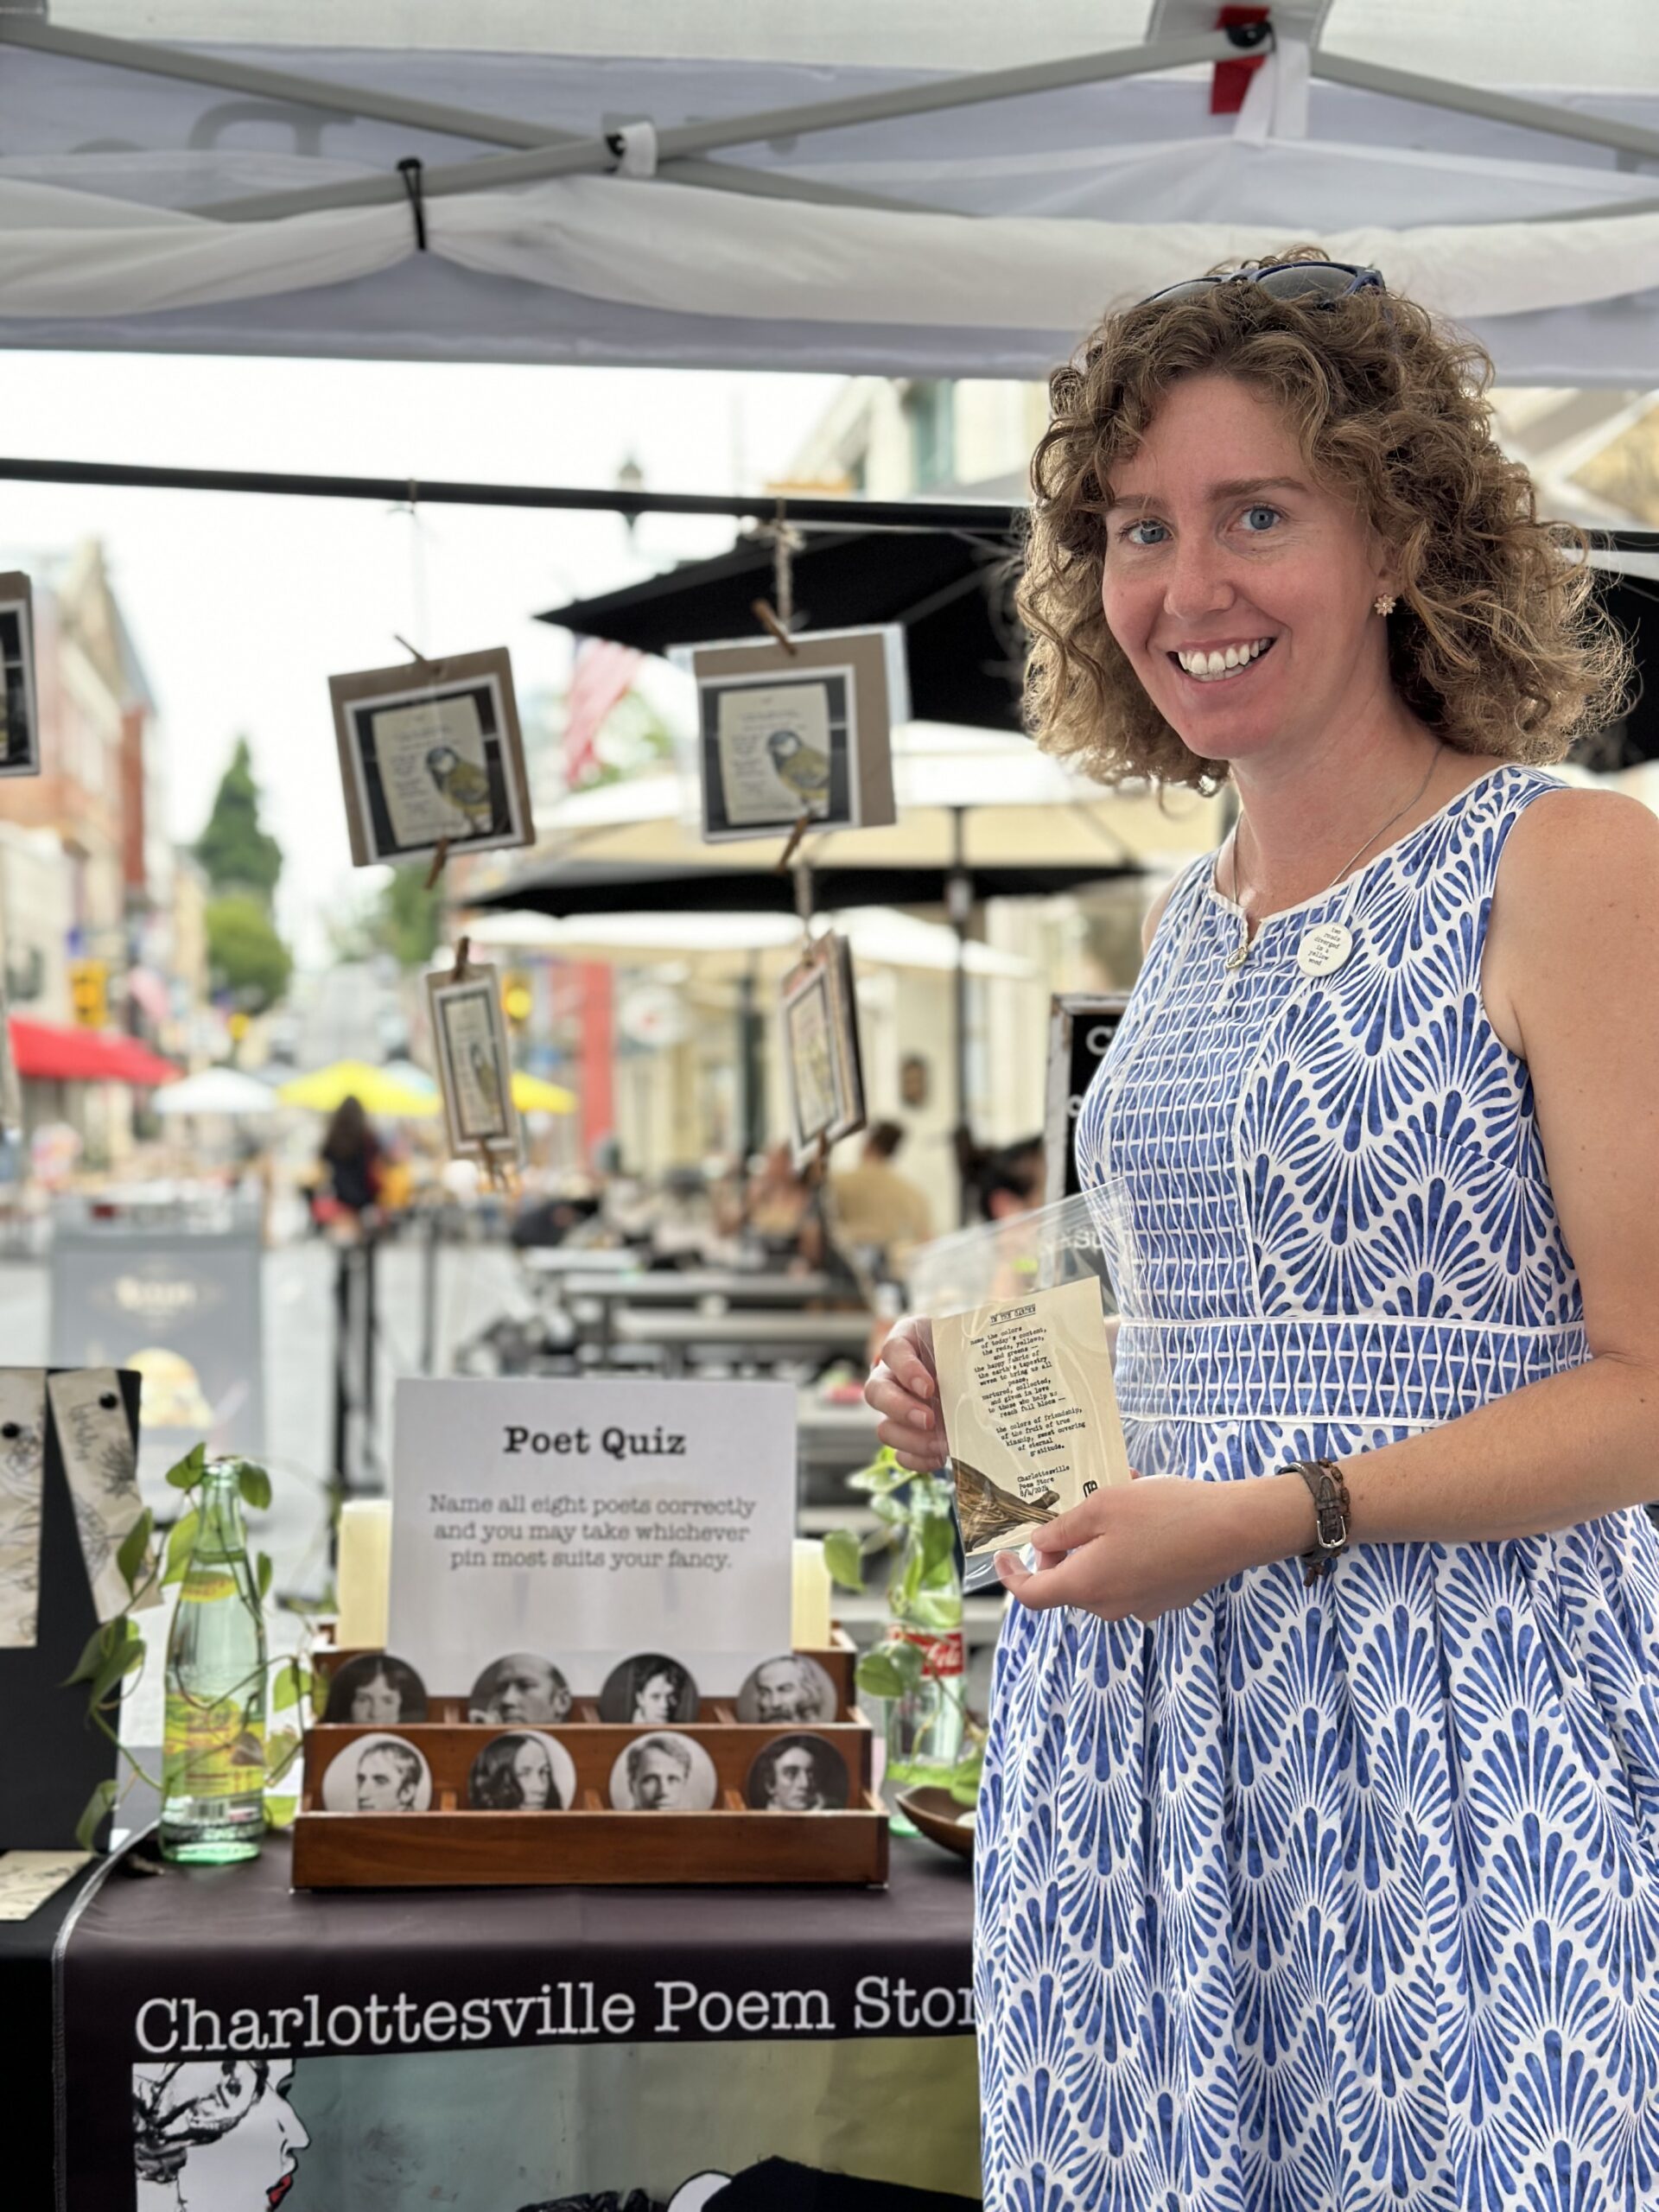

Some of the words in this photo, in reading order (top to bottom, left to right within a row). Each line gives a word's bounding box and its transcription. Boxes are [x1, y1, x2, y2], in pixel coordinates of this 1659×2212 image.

[1001, 1327, 1022, 1336] colors
[1010, 1421, 1032, 1430] colors
[1026, 1424, 1043, 1433] fruit
[503, 1427, 590, 1454] Poet
[601, 1427, 687, 1459] Quiz
[1018, 1465, 1070, 1483] Charlottesville
[429, 1494, 493, 1514] Name
[498, 1495, 525, 1513] all
[531, 1495, 588, 1517] eight
[593, 1497, 651, 1517] poets
[656, 1496, 757, 1519] correctly
[435, 1522, 476, 1540] and
[480, 1526, 523, 1543] you
[529, 1526, 576, 1544] may
[582, 1522, 630, 1541] take
[636, 1522, 750, 1542] whichever
[451, 1550, 486, 1571] pin
[493, 1552, 548, 1568] most
[552, 1549, 605, 1568] suits
[609, 1553, 664, 1572] your
[668, 1549, 732, 1573] fancy.
[136, 1982, 636, 2053] Charlottesville
[655, 1981, 836, 2032] Poem
[855, 1976, 975, 2029] Stor
